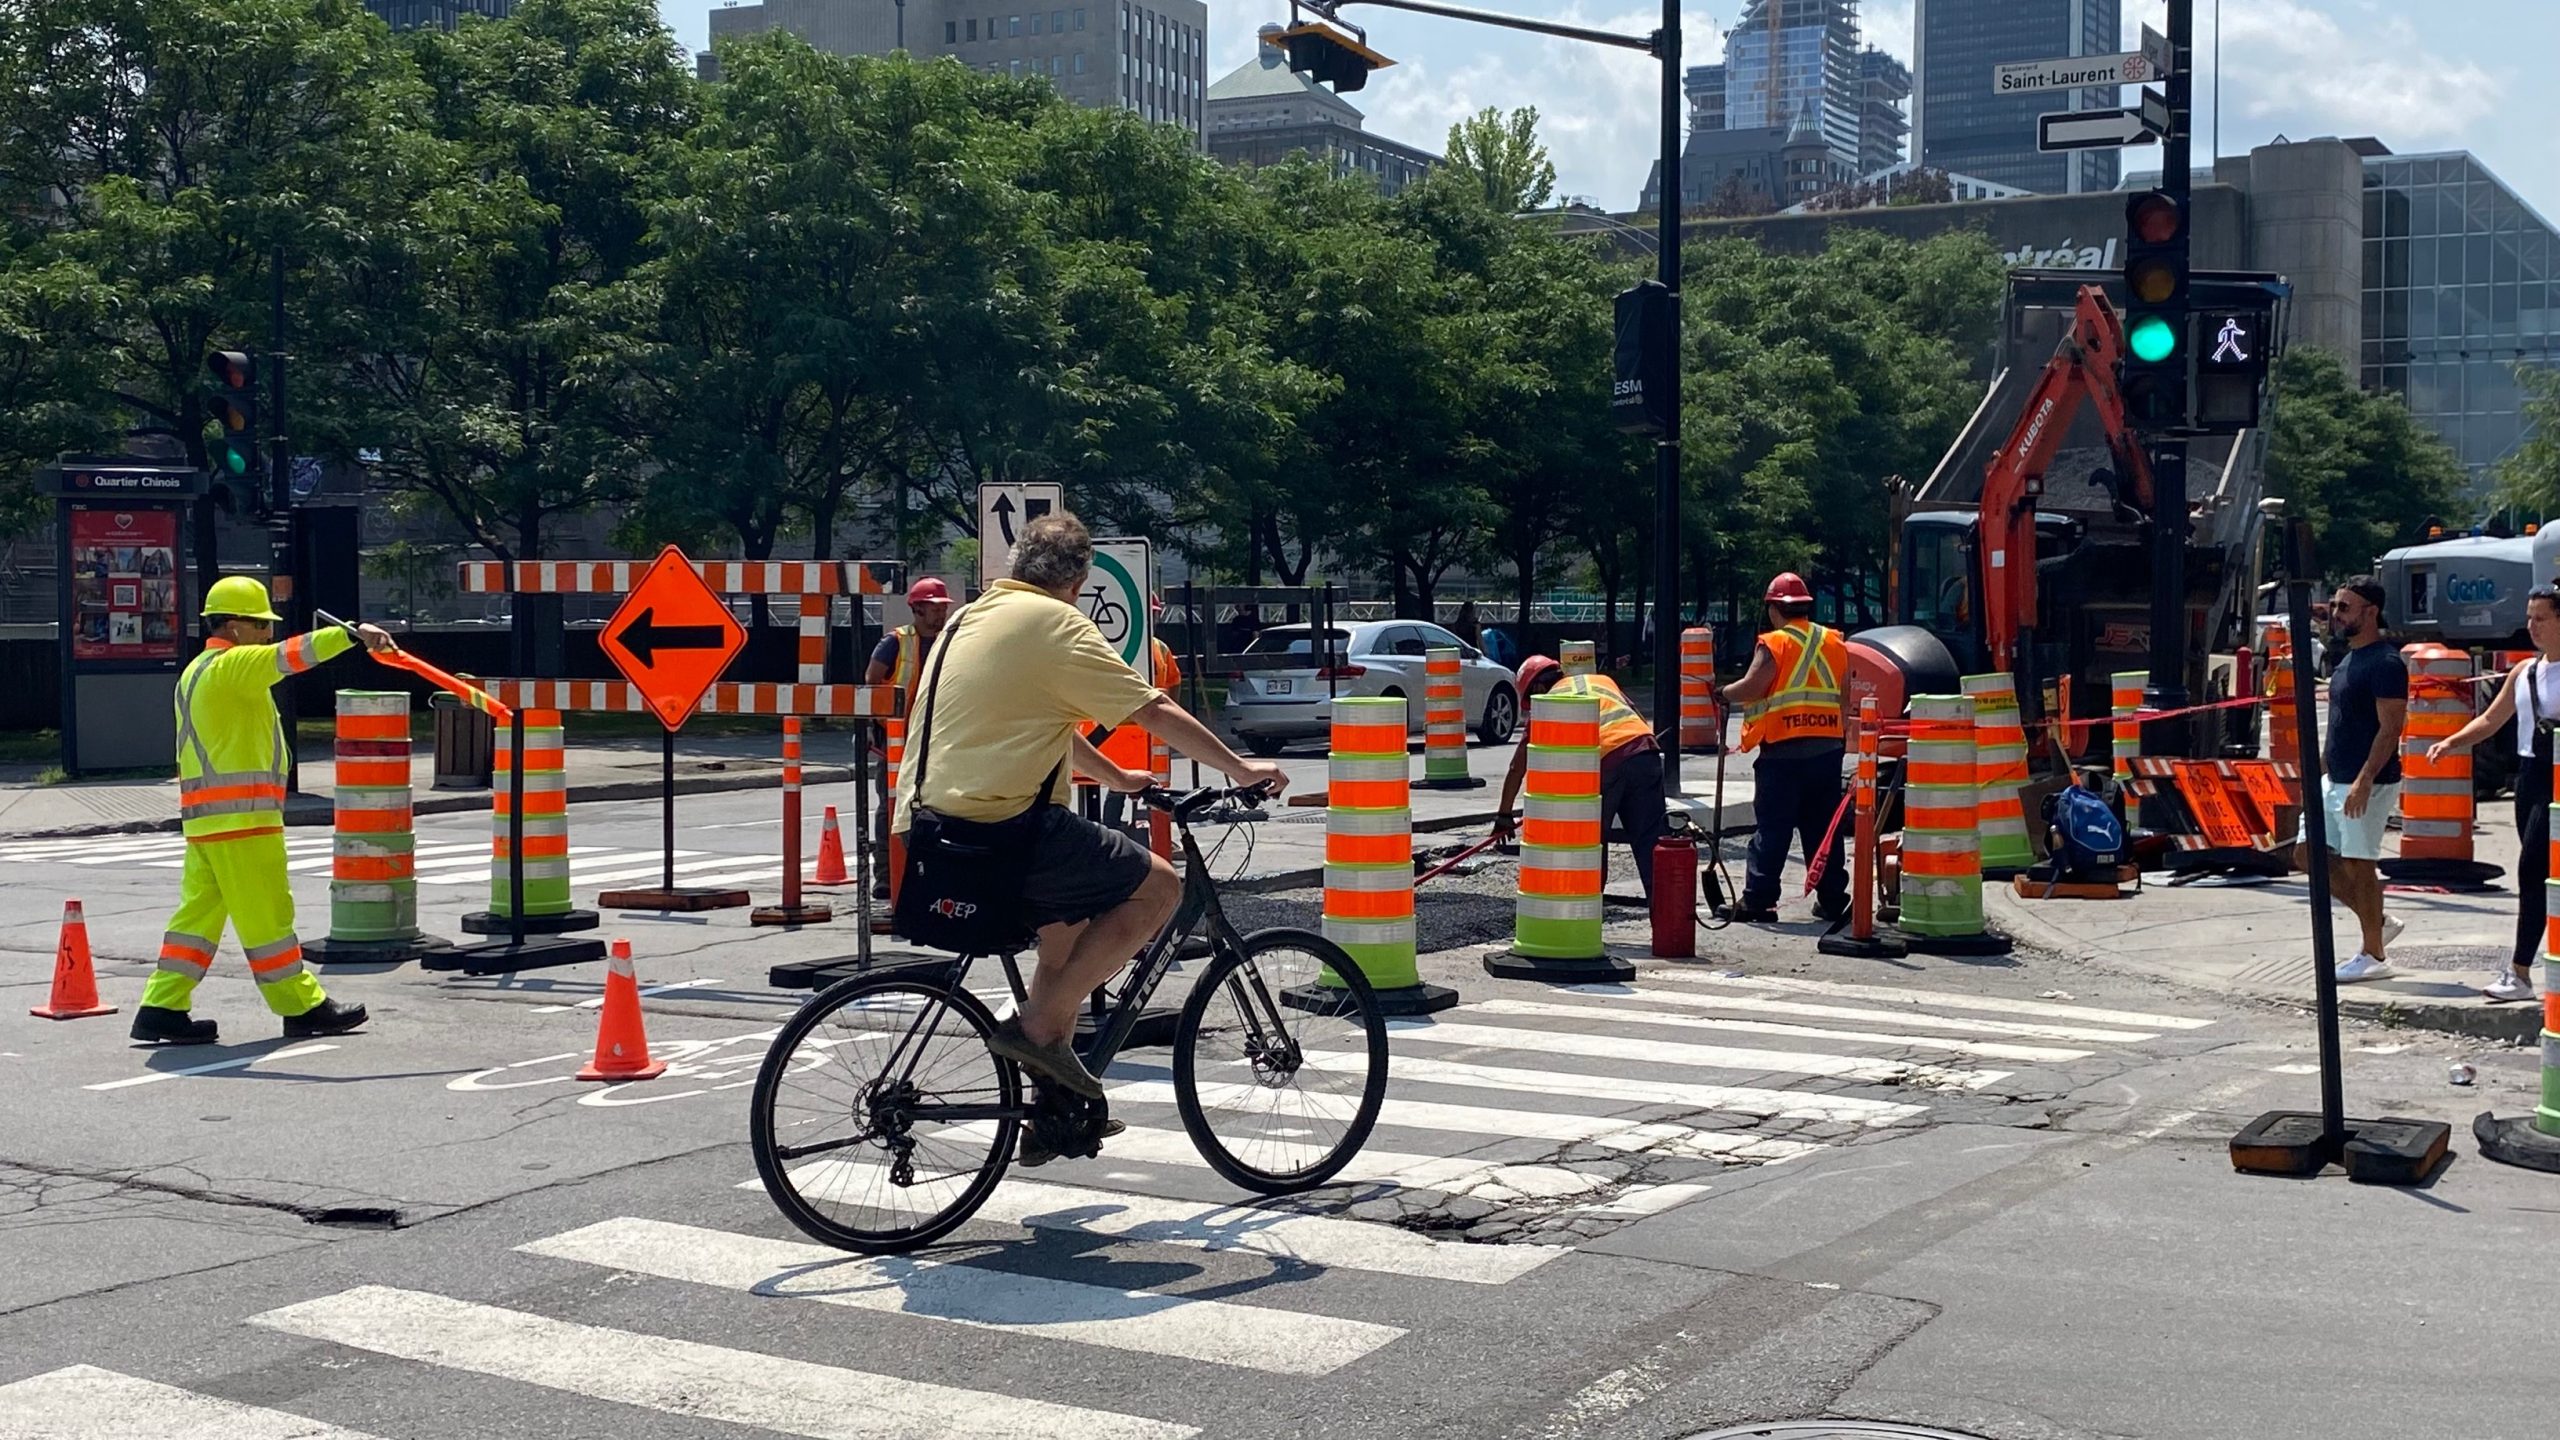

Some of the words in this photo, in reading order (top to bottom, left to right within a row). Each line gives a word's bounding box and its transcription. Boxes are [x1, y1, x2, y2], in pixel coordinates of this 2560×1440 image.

[2001, 66, 2116, 90] Saint-Laurent
[2003, 238, 2118, 269] ntréal
[2018, 398, 2054, 457] KUBOTA
[94, 475, 138, 487] Quartier
[141, 476, 181, 488] Chinois
[2447, 573, 2496, 602] Genie
[929, 898, 977, 919] AQEP
[1128, 928, 1184, 1012] TREK
